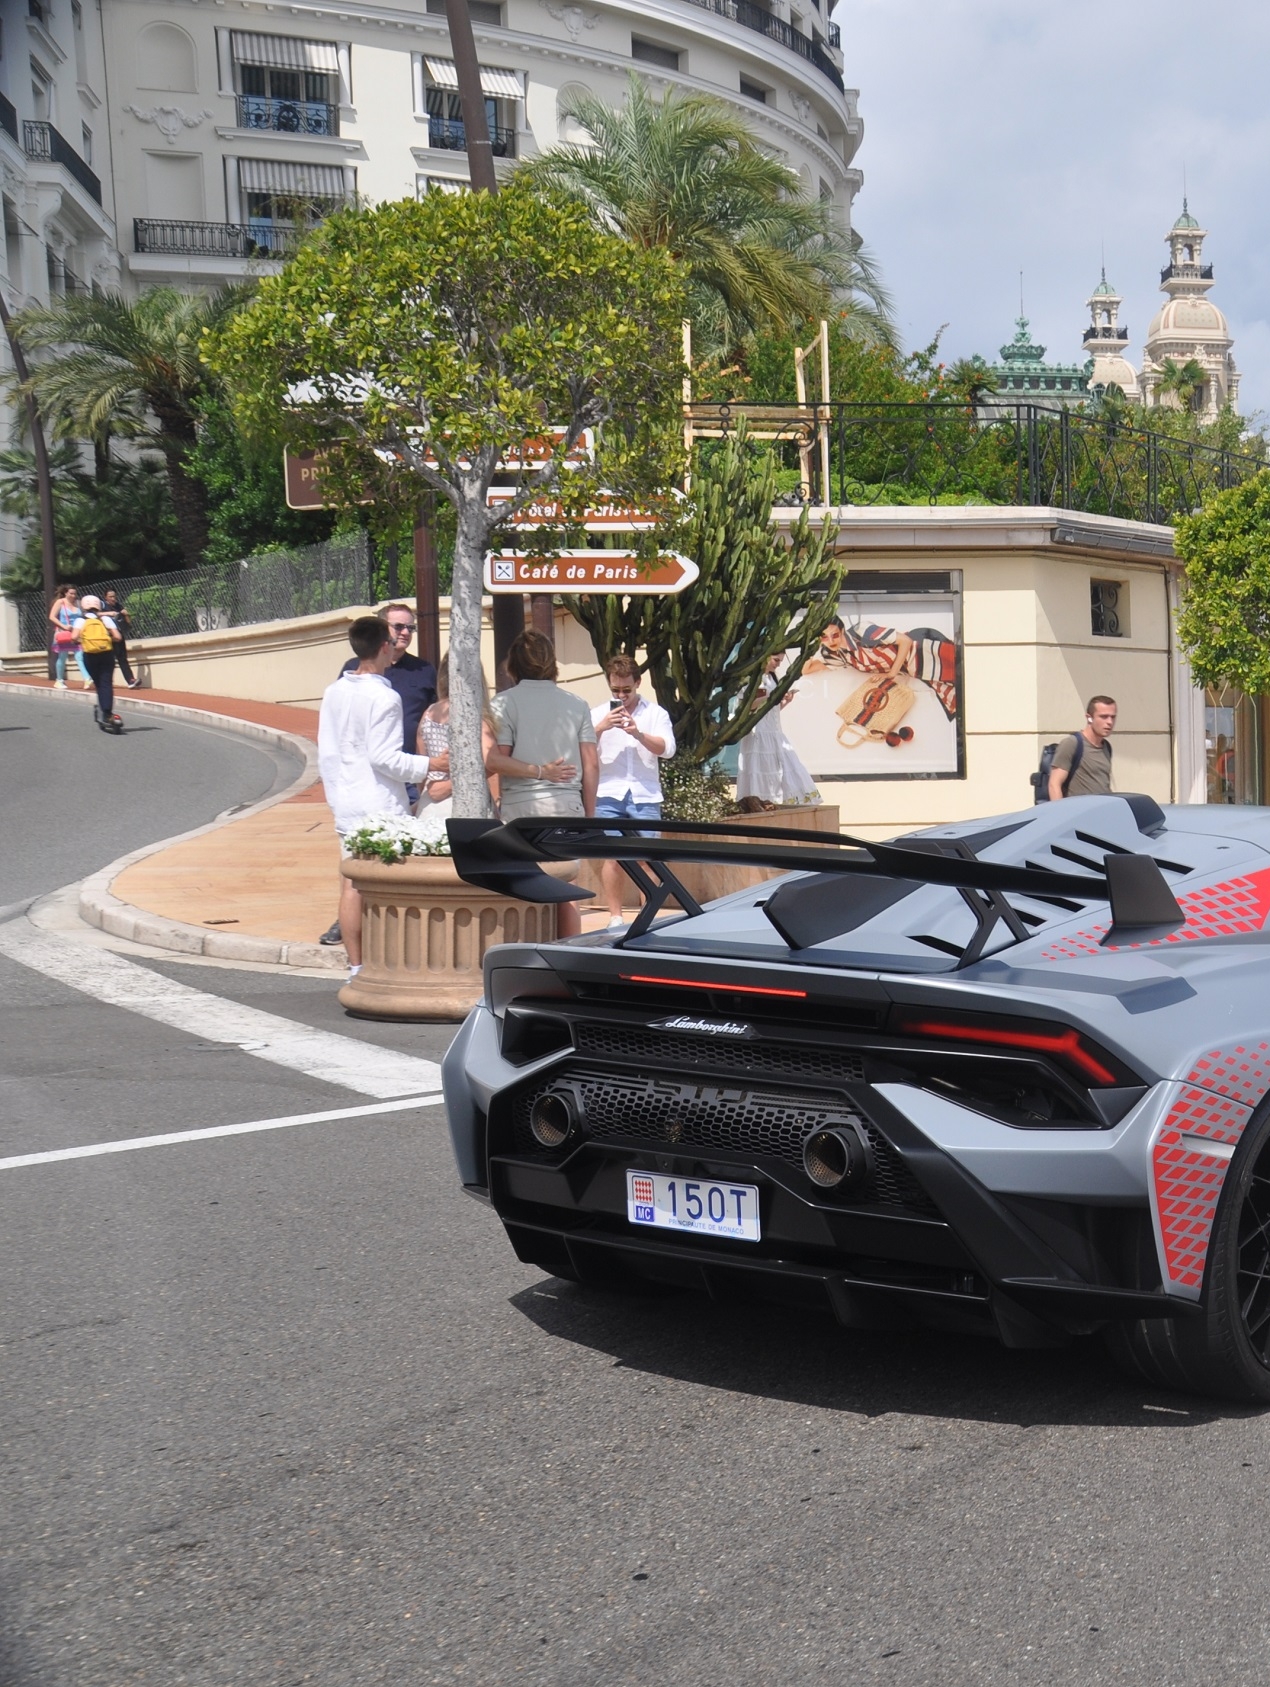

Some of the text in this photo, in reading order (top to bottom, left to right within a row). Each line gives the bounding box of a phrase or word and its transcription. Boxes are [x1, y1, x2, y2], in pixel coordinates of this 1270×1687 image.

[519, 564, 638, 579] Café de Paris
[665, 1015, 748, 1035] Lamborghini
[667, 1181, 747, 1226] 150T
[637, 1207, 651, 1220] MC
[708, 1223, 717, 1231] DE
[718, 1224, 745, 1236] MONACO
